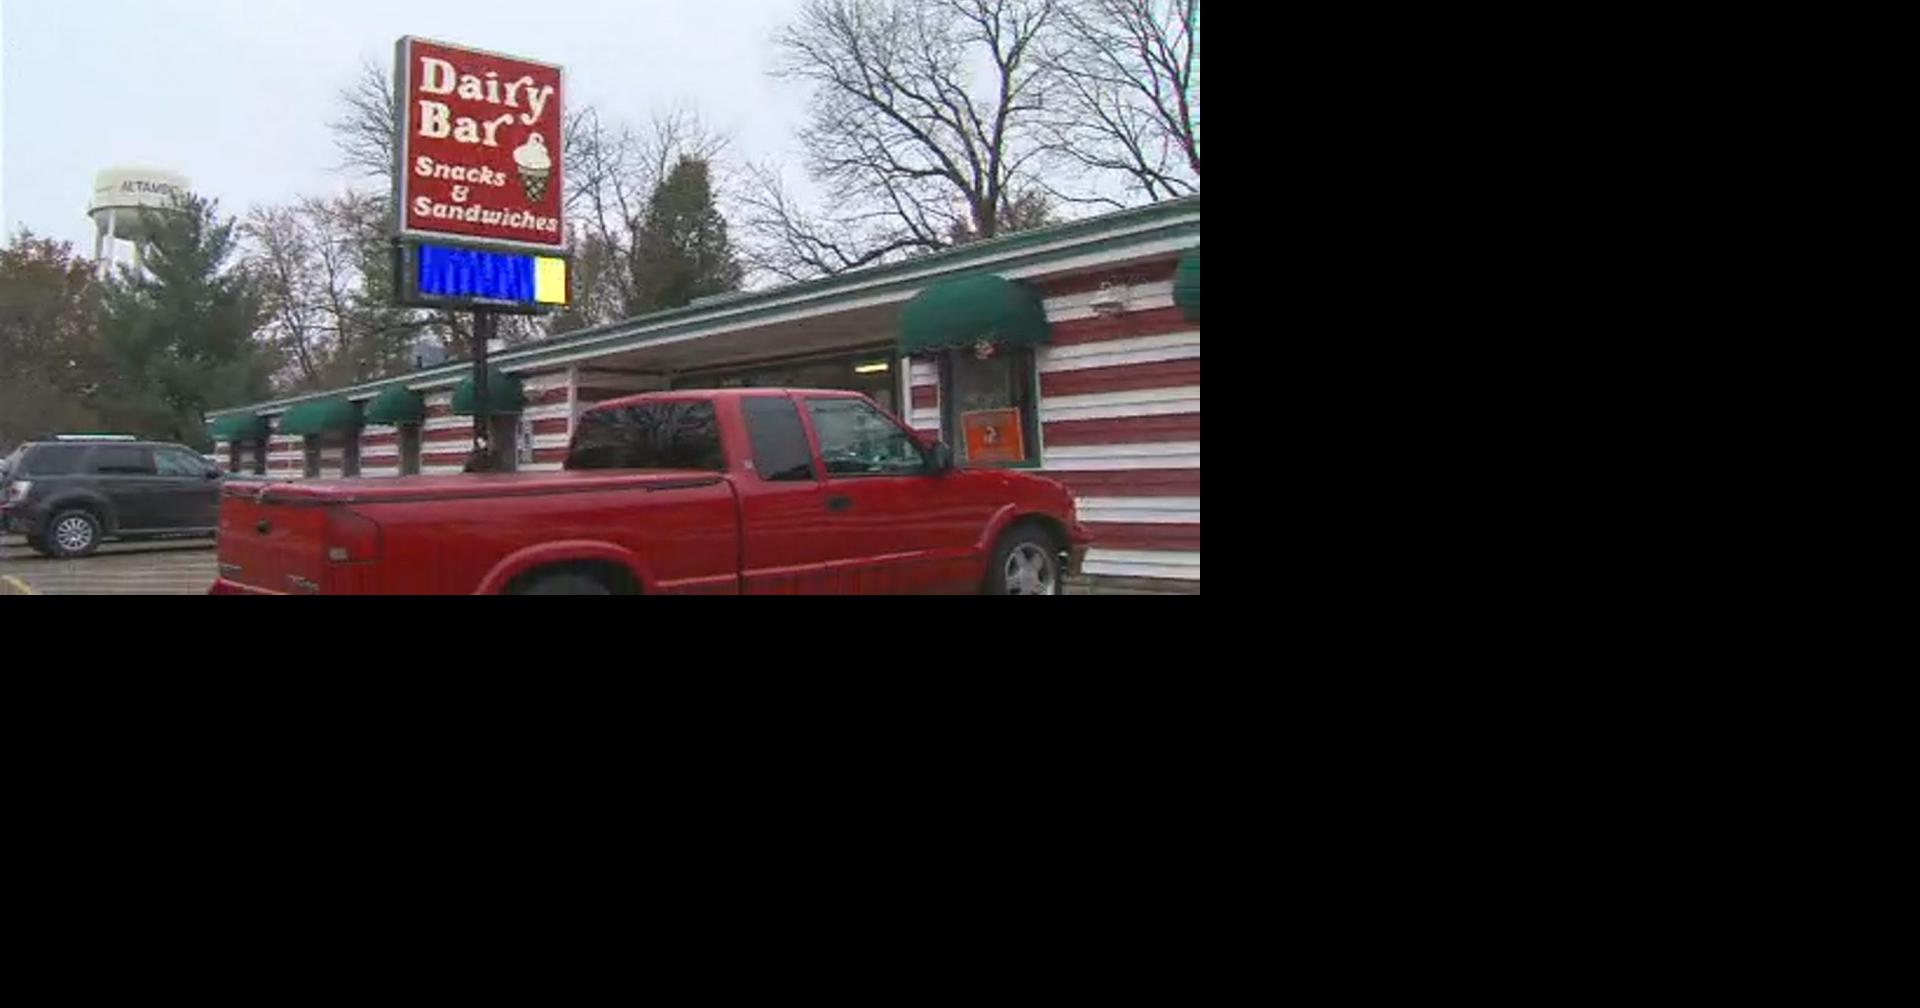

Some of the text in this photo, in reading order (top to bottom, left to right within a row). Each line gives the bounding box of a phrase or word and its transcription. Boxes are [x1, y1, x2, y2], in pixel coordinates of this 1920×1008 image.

[419, 56, 554, 124] Dairy
[419, 99, 514, 147] Bar
[415, 155, 506, 187] Snacks
[451, 185, 469, 202] &
[414, 196, 559, 232] Sandwiches
